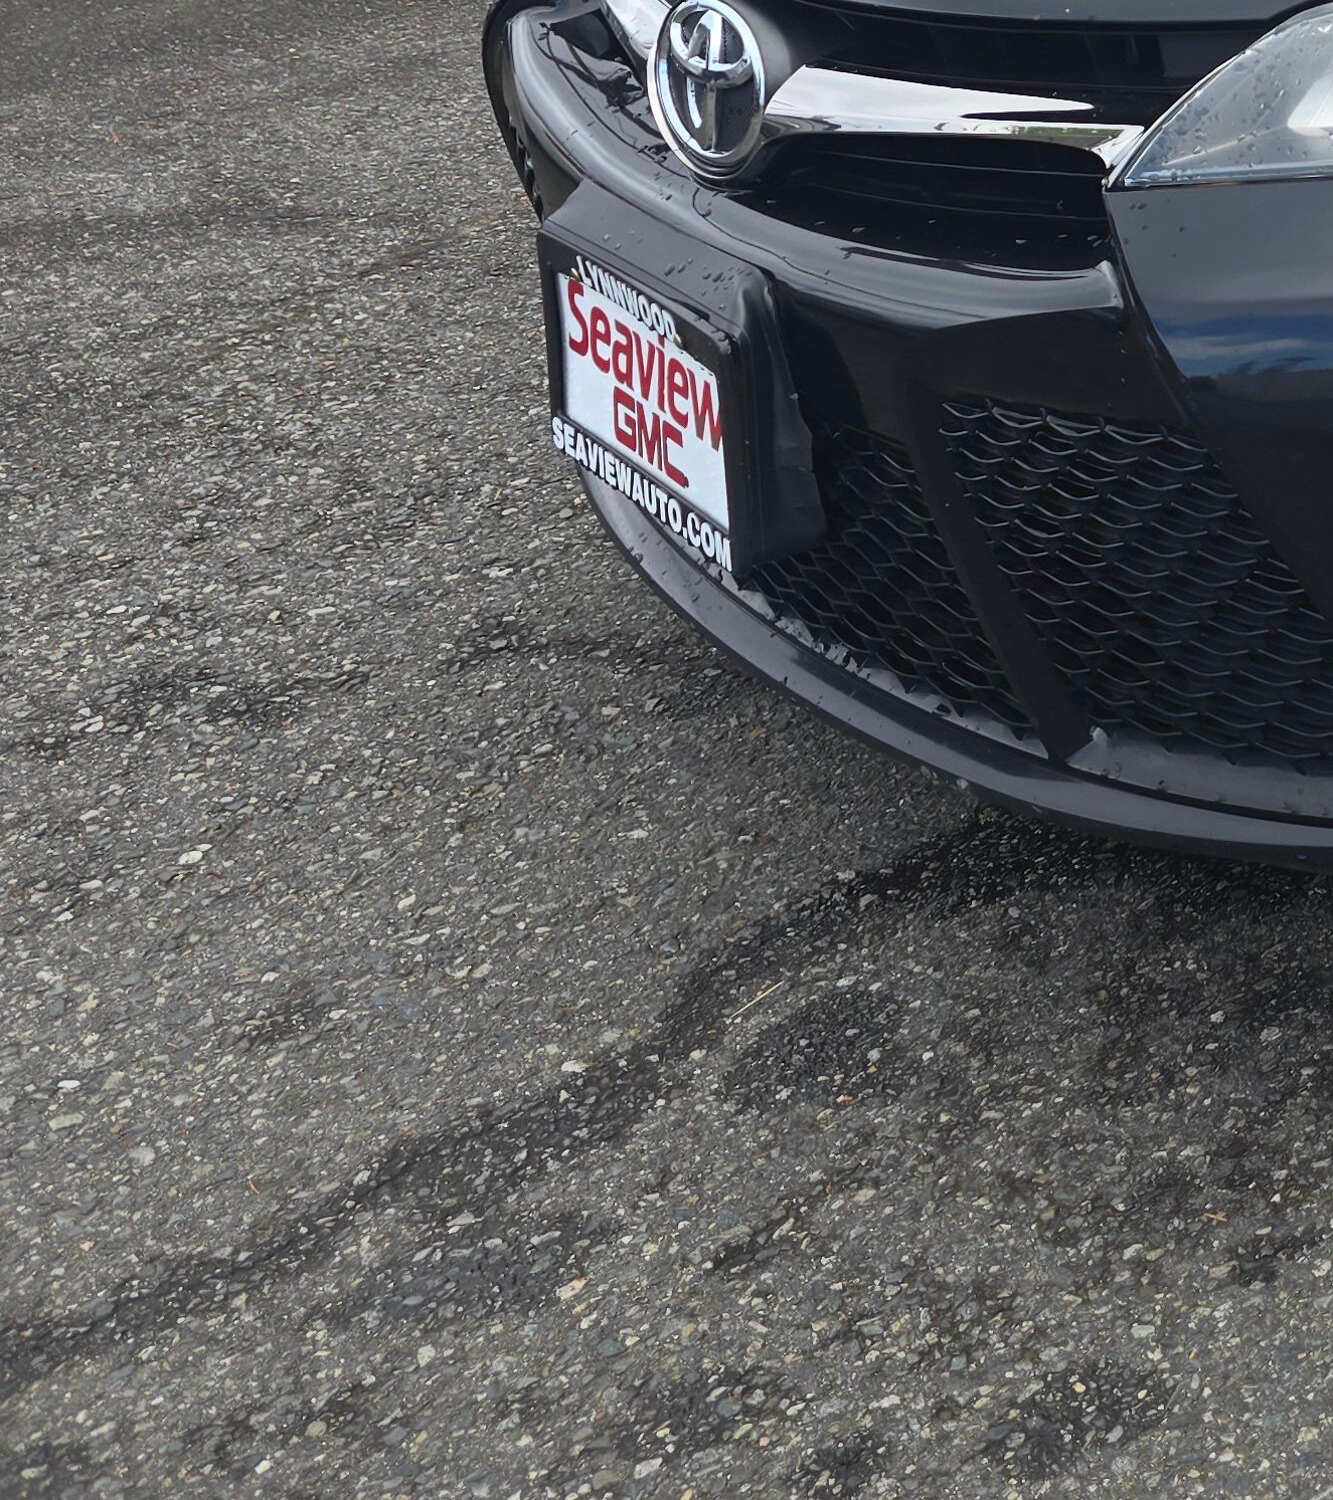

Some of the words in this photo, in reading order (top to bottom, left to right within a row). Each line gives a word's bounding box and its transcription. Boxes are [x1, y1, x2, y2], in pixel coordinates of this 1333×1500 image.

[575, 255, 676, 342] LYNNWOOD
[567, 277, 723, 453] Seaview
[551, 415, 733, 573] SEAVIEWAUTO.COM
[613, 385, 690, 490] GMC
